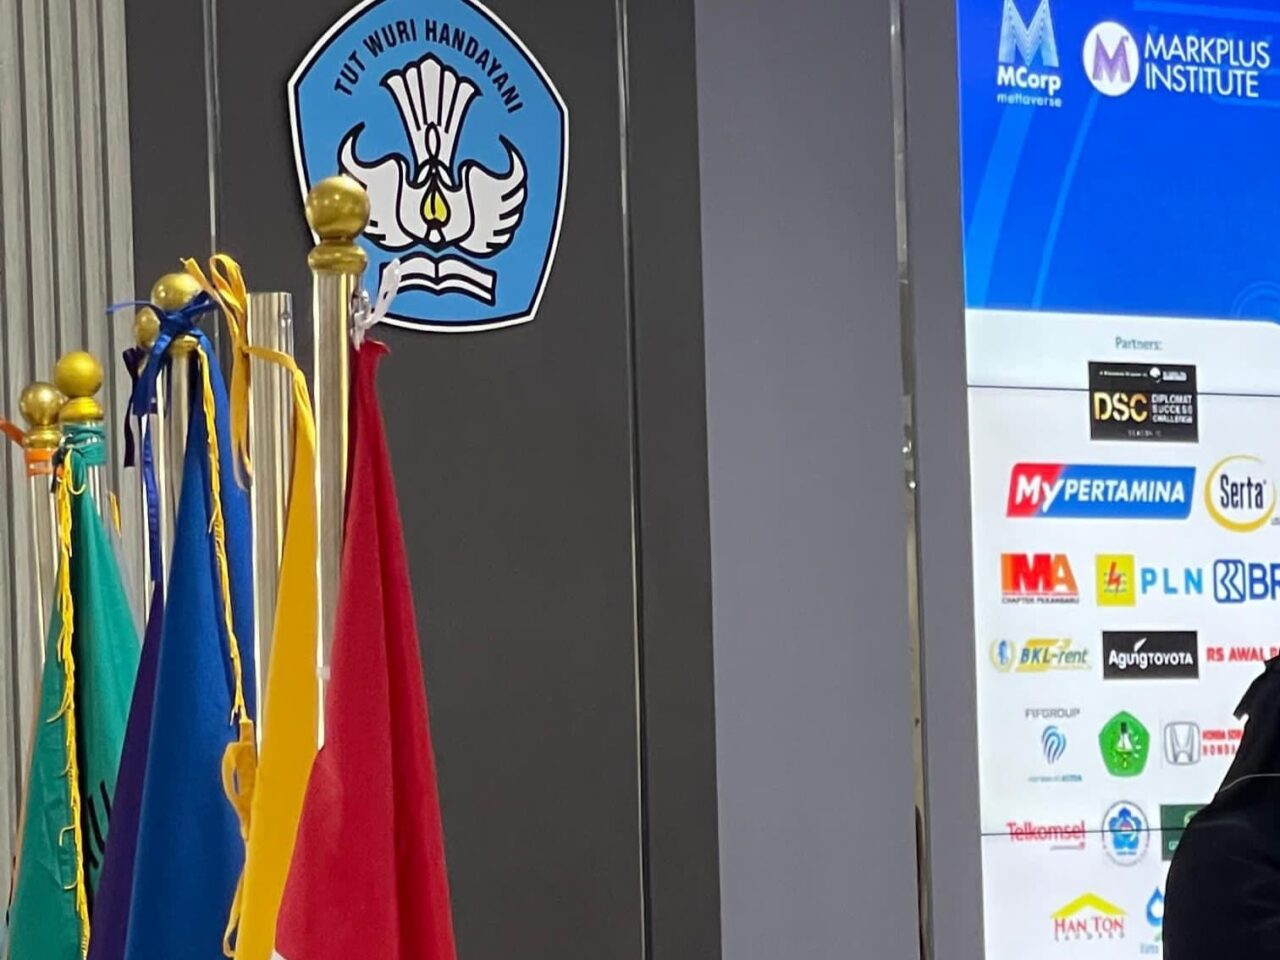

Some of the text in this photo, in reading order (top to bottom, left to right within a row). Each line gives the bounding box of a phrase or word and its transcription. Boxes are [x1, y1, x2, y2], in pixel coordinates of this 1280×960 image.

[334, 18, 525, 115] TUT WURI HANDAYANI
[1144, 33, 1271, 70] MARKPLUS
[997, 64, 1061, 97] MCorp
[1146, 62, 1259, 98] INSTITUTE
[1115, 336, 1163, 351] Partners:
[1093, 390, 1149, 423] DSC
[1220, 473, 1263, 510] Serta
[1001, 554, 1079, 592] IMA
[1141, 567, 1203, 595] PLN
[1019, 648, 1088, 666] BKL-rent
[1206, 647, 1224, 662] RS
[1229, 647, 1266, 662] AWAL
[1025, 708, 1080, 719] FIFGROUP
[1006, 819, 1085, 842] Telkomsel
[1054, 916, 1124, 934] HAN TON
